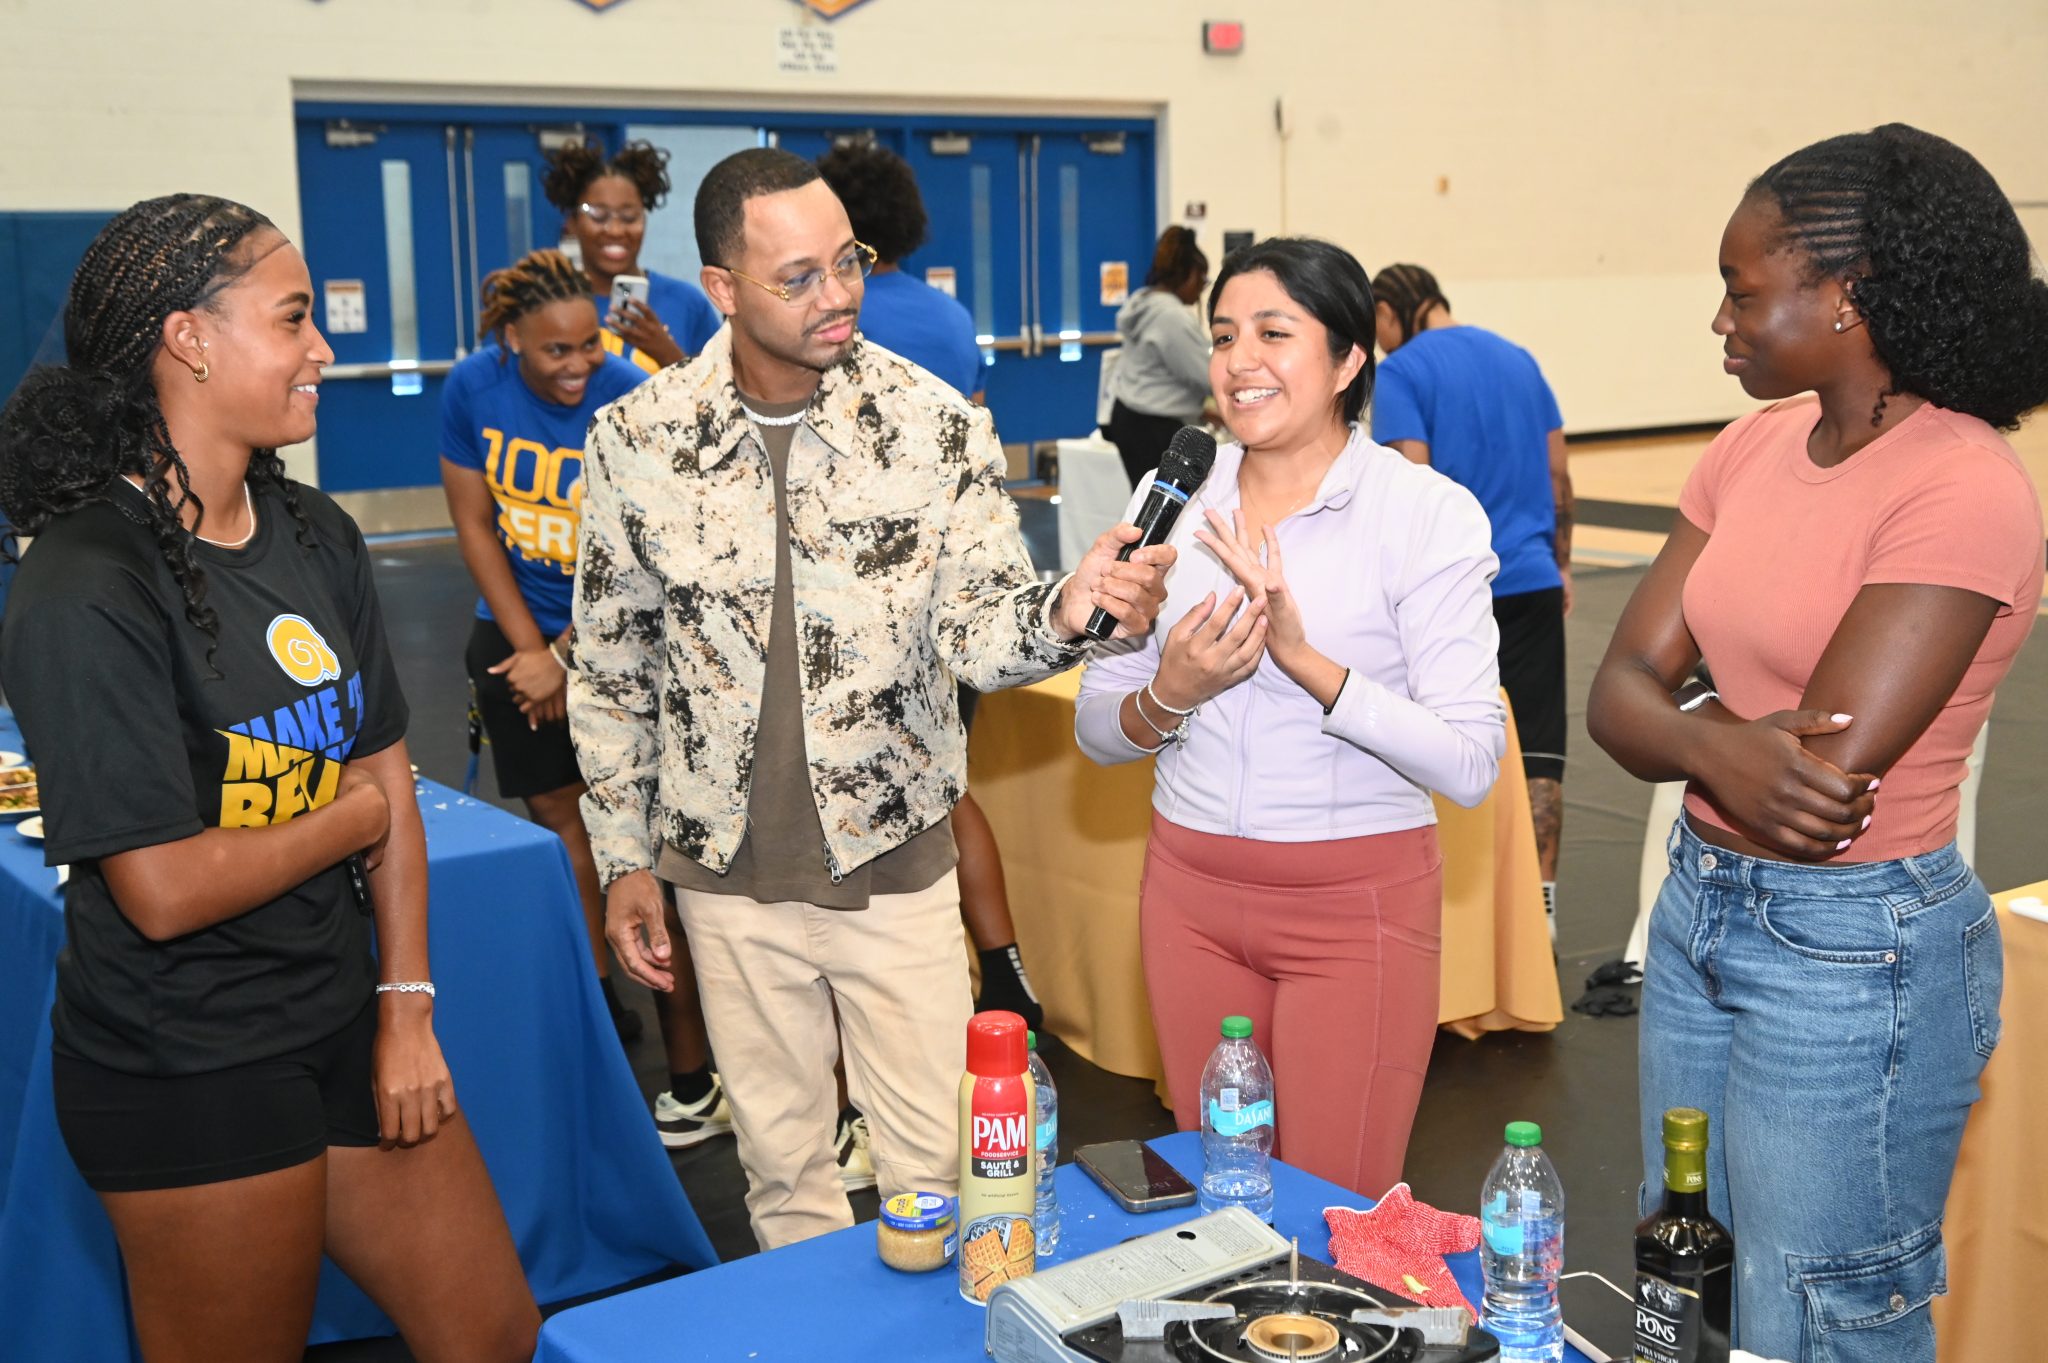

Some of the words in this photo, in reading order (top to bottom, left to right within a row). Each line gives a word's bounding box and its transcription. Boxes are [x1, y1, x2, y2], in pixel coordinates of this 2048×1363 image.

[214, 687, 344, 781] MAKE
[973, 1114, 1026, 1151] PAM
[980, 1159, 1012, 1170] SAUTÉ
[1013, 1160, 1020, 1169] &
[981, 1150, 1019, 1158] FOODSERVICE
[986, 1169, 1014, 1178] GRILL
[1636, 1310, 1676, 1343] PONS
